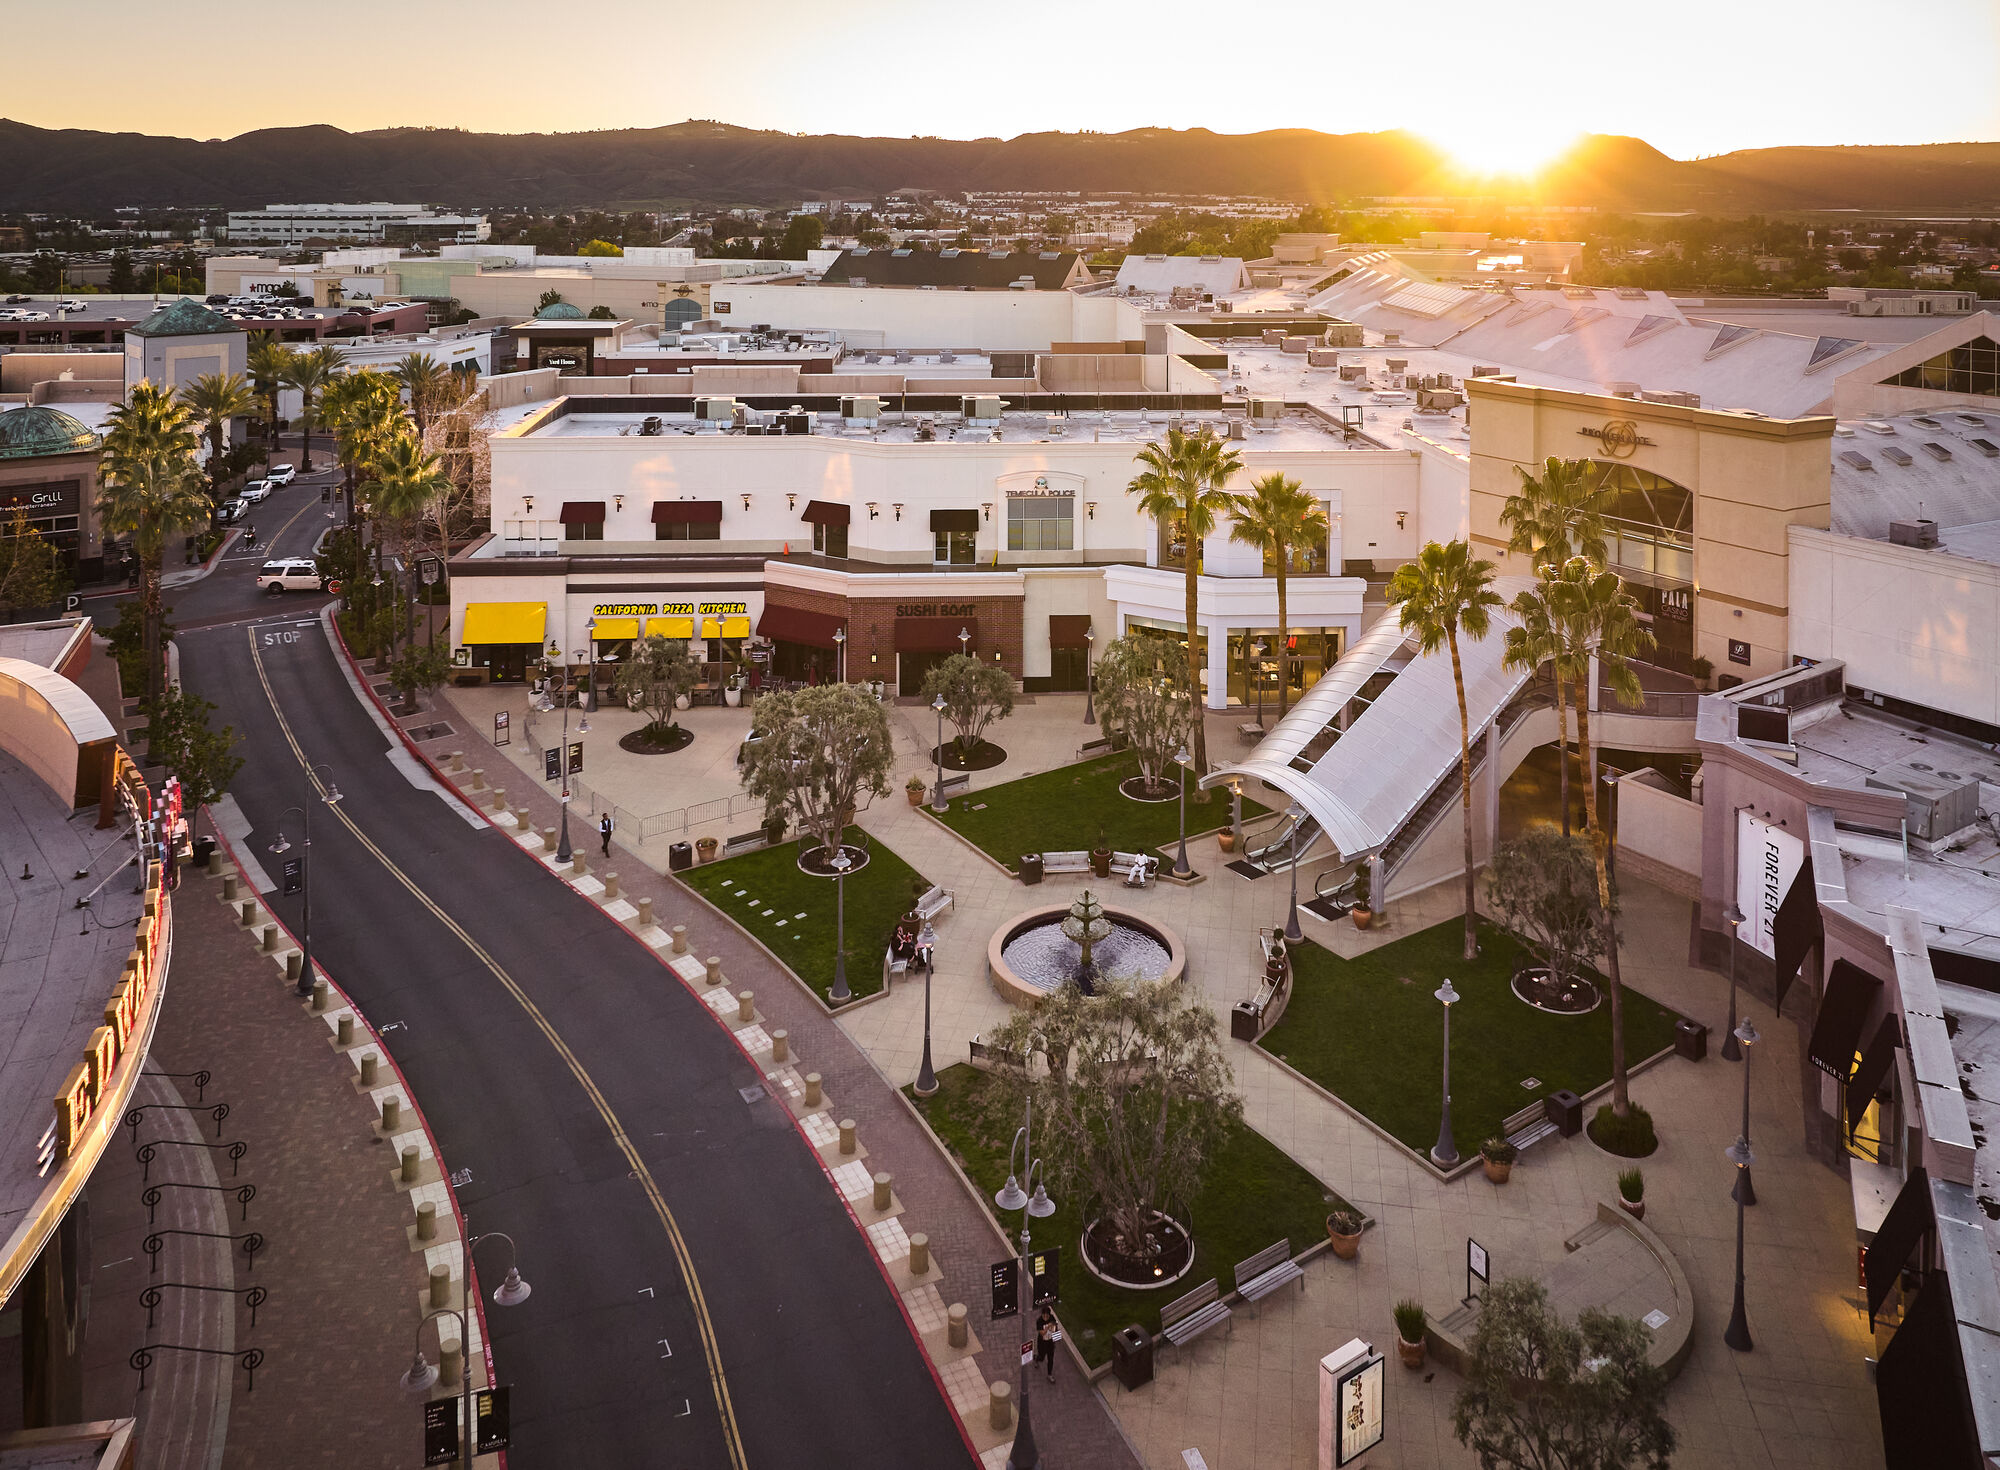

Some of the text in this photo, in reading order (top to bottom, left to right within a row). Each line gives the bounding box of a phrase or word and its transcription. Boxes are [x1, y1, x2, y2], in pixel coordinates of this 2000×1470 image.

[32, 492, 63, 503] Grill
[1006, 490, 1046, 498] TEMECULA
[1661, 591, 1688, 610] PALA
[592, 602, 747, 616] CALIFORNIA PIZZA KITCHEN
[895, 604, 976, 616] SUSHI BOAT
[264, 631, 302, 646] STOP
[1764, 841, 1779, 915] FOREVER
